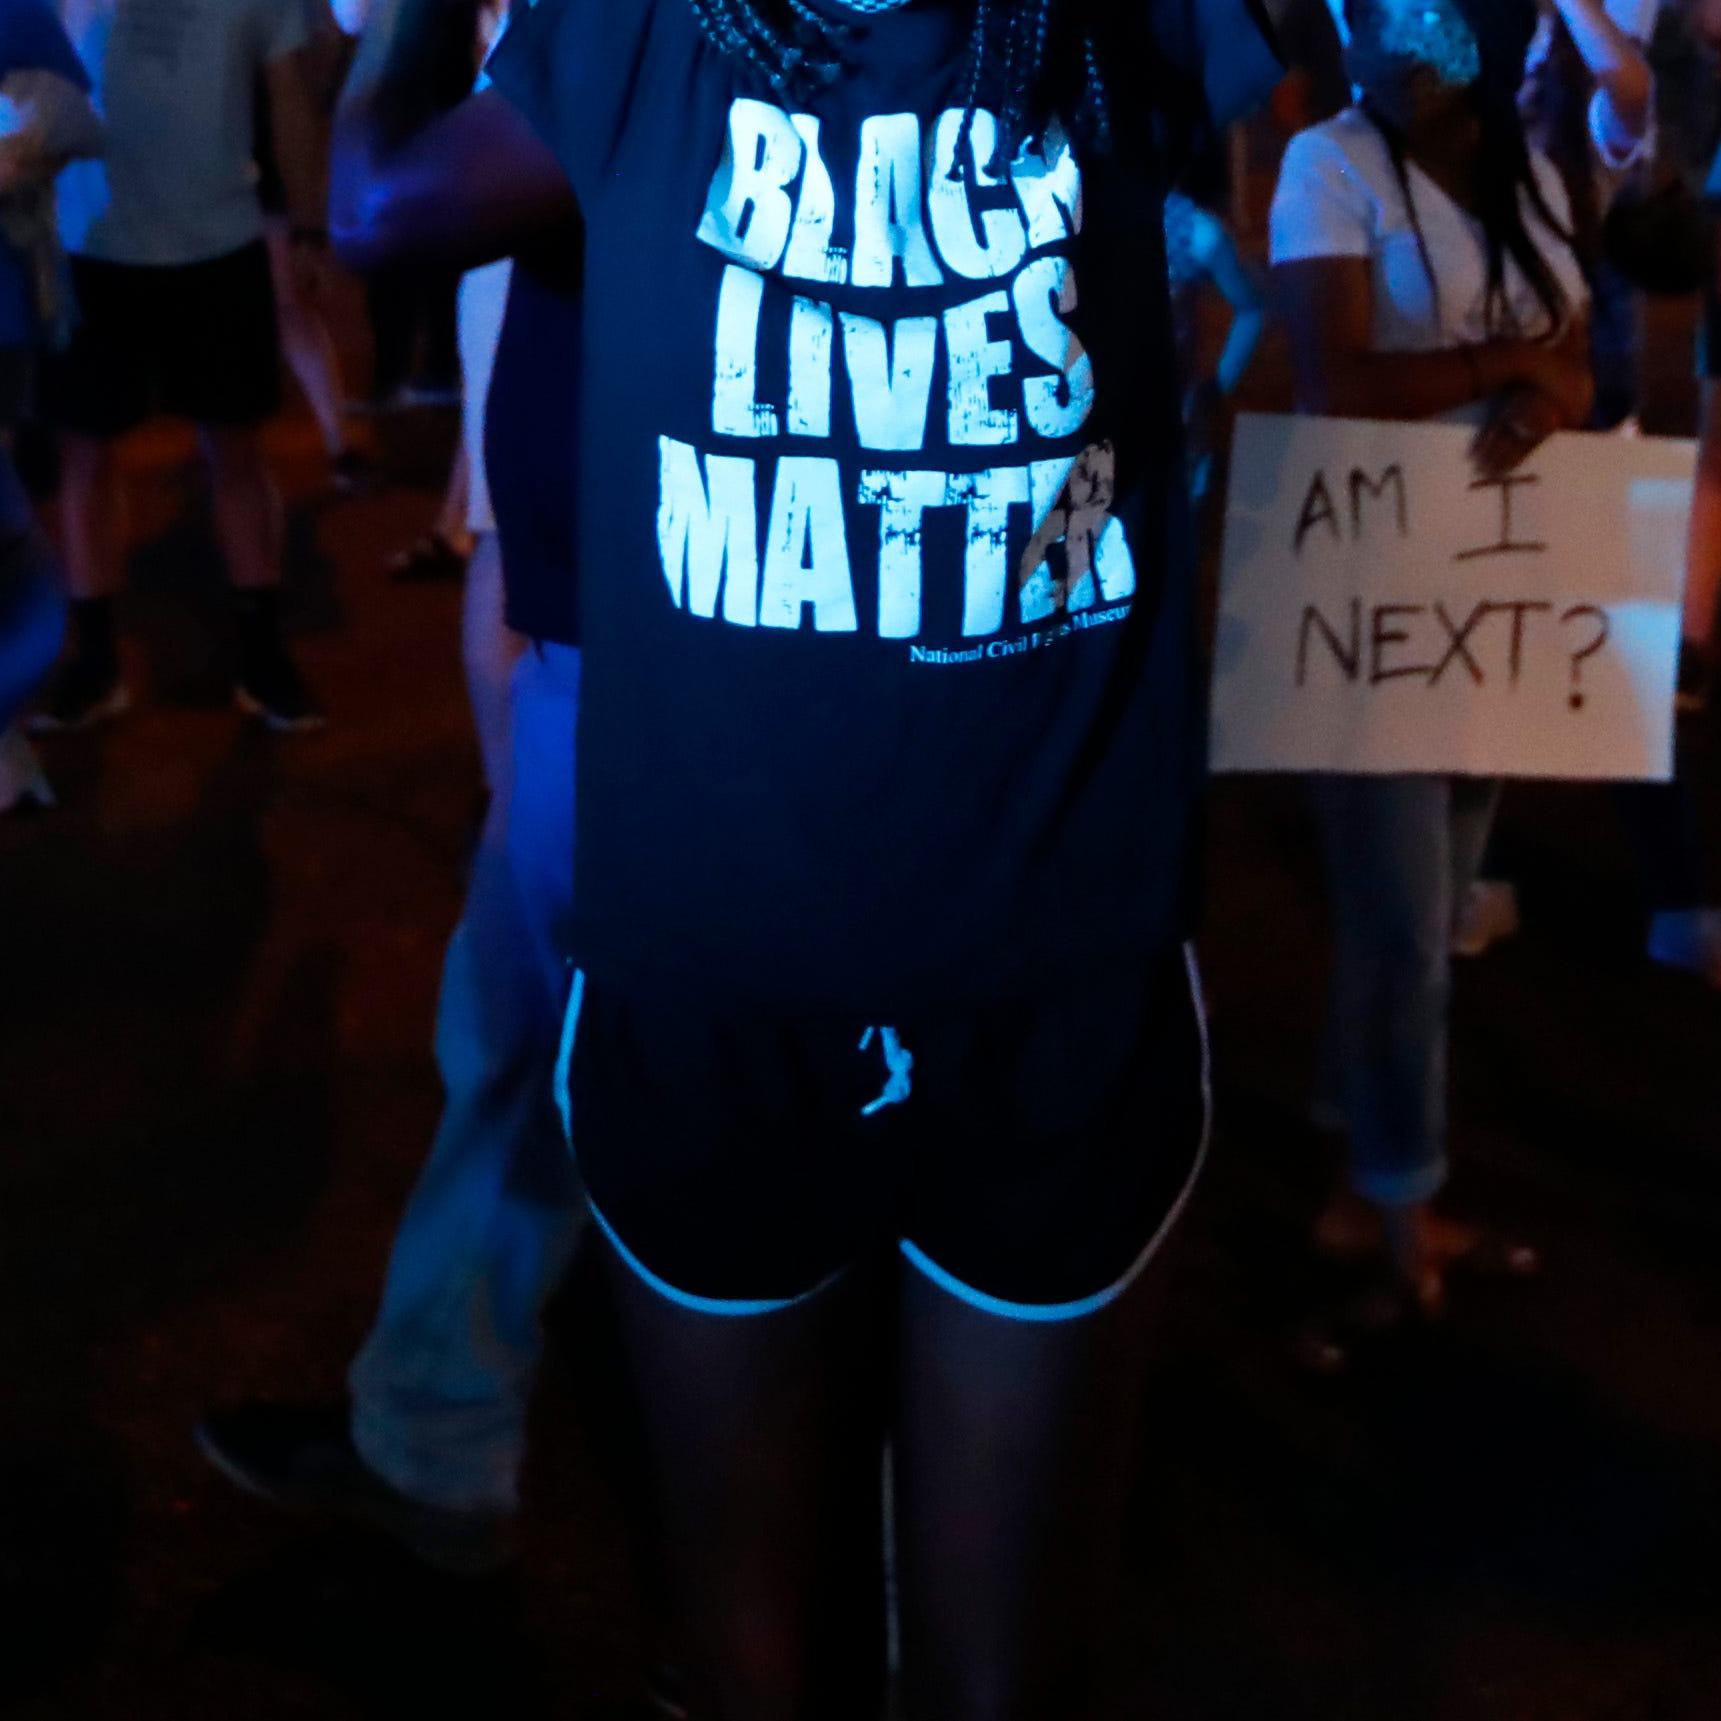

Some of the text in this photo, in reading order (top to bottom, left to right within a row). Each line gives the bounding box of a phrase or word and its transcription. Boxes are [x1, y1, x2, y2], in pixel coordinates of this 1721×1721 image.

[711, 256, 1095, 452] LIVES
[1292, 462, 1547, 562] AM I
[909, 643, 983, 665] National
[986, 634, 1029, 659] Civil
[1293, 595, 1611, 712] NEXT?
